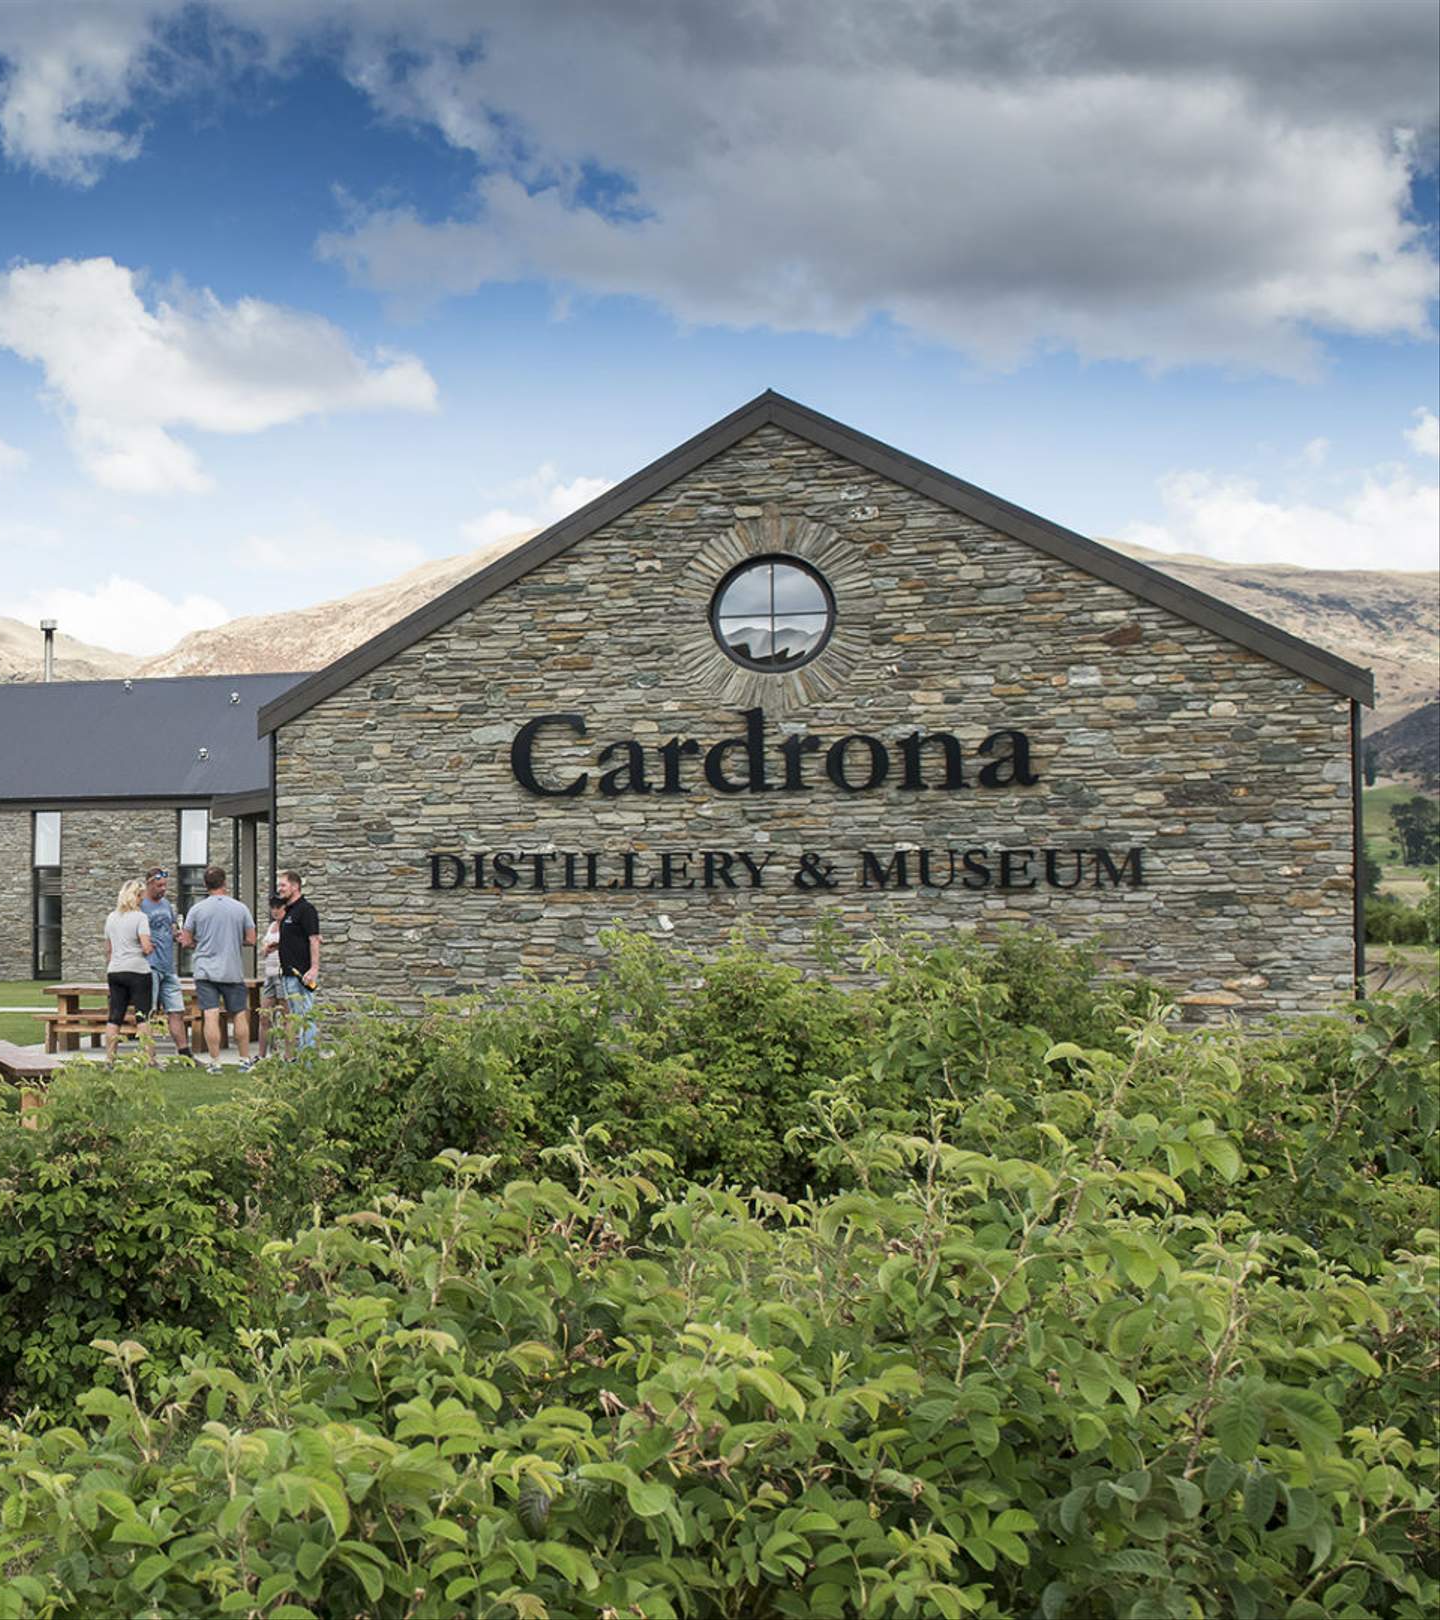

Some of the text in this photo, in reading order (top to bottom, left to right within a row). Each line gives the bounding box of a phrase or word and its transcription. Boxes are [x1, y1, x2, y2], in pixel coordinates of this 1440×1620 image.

[511, 707, 1039, 798] Cardrona
[426, 847, 1147, 892] DISTILLERY & MUSEUM
